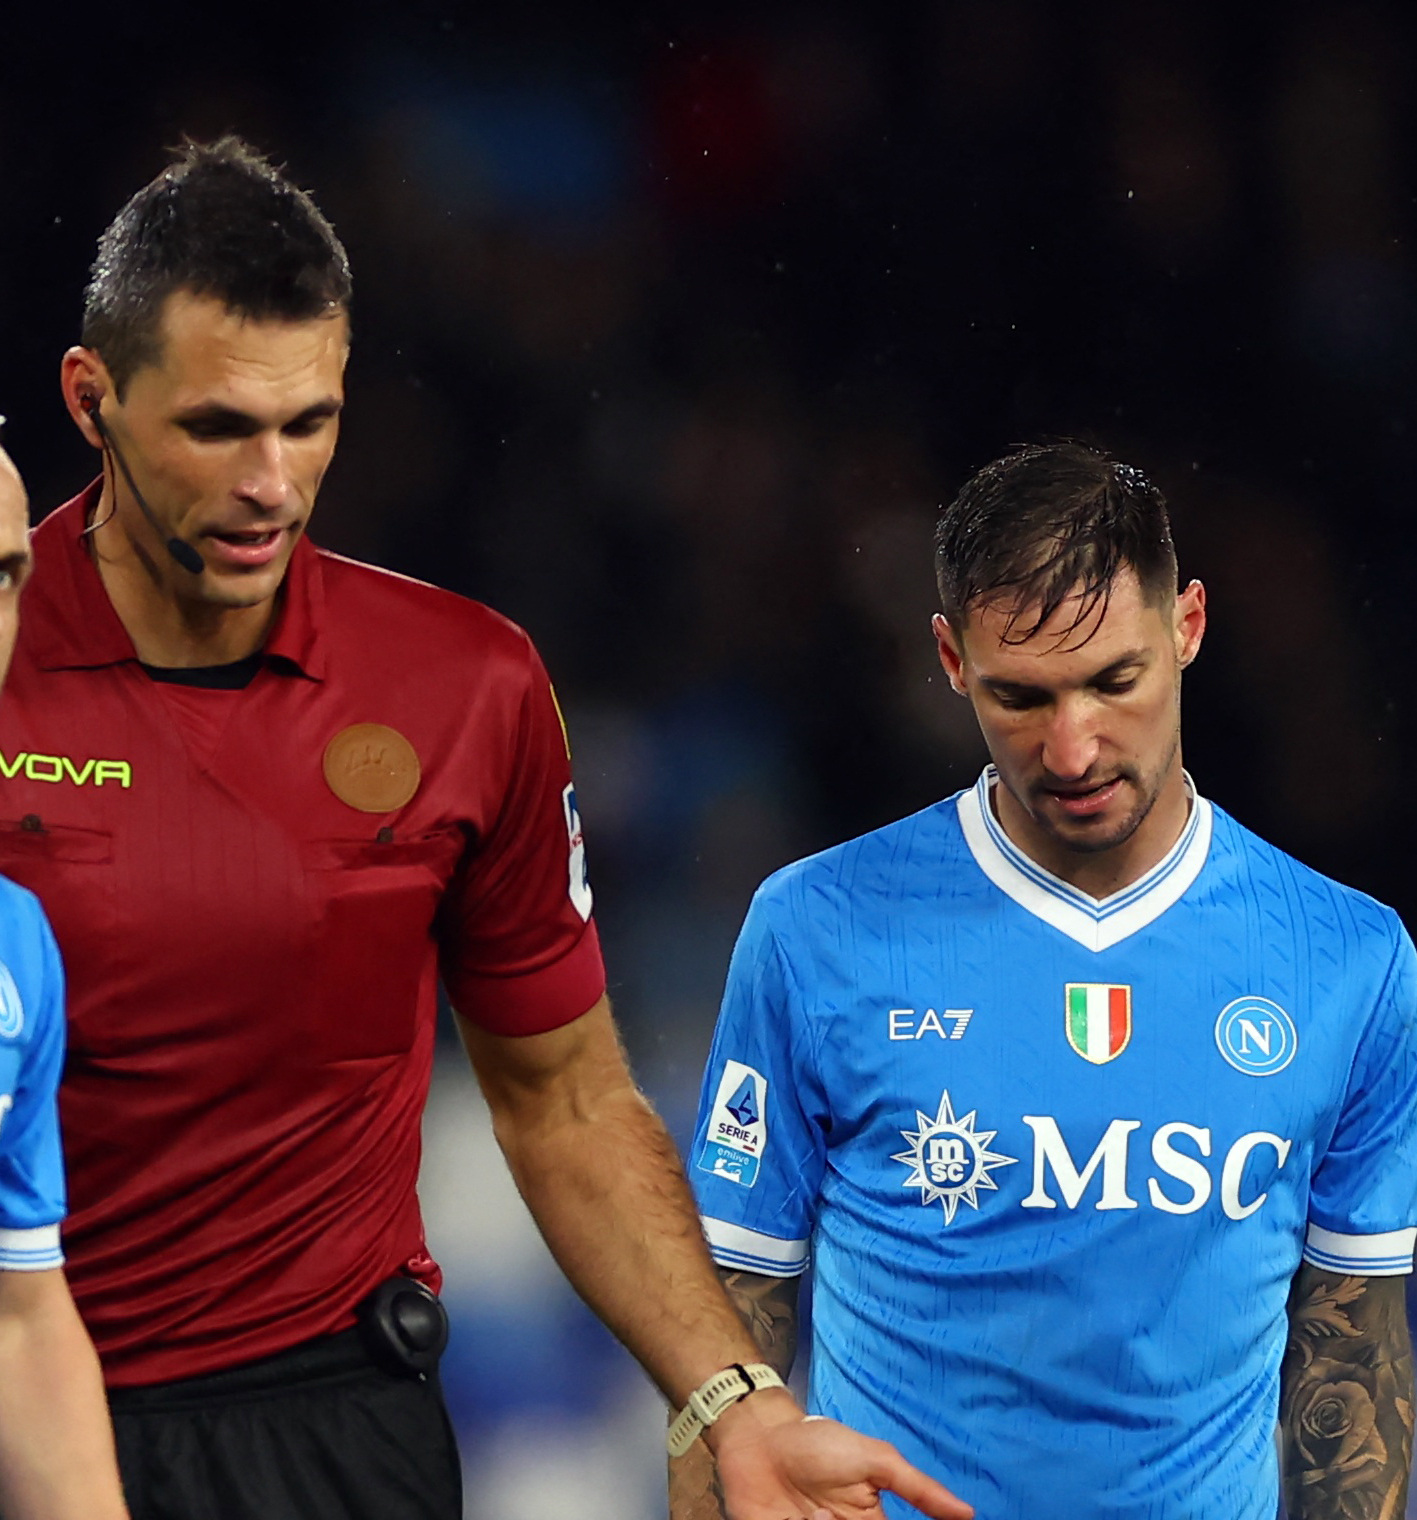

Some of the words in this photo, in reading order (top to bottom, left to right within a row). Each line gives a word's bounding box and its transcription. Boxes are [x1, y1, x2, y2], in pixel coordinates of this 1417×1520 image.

[889, 1008, 974, 1041] EA7
[1239, 1018, 1274, 1056] N
[717, 1123, 751, 1143] SERIE
[750, 1135, 759, 1146] A
[1020, 1115, 1293, 1221] MSC
